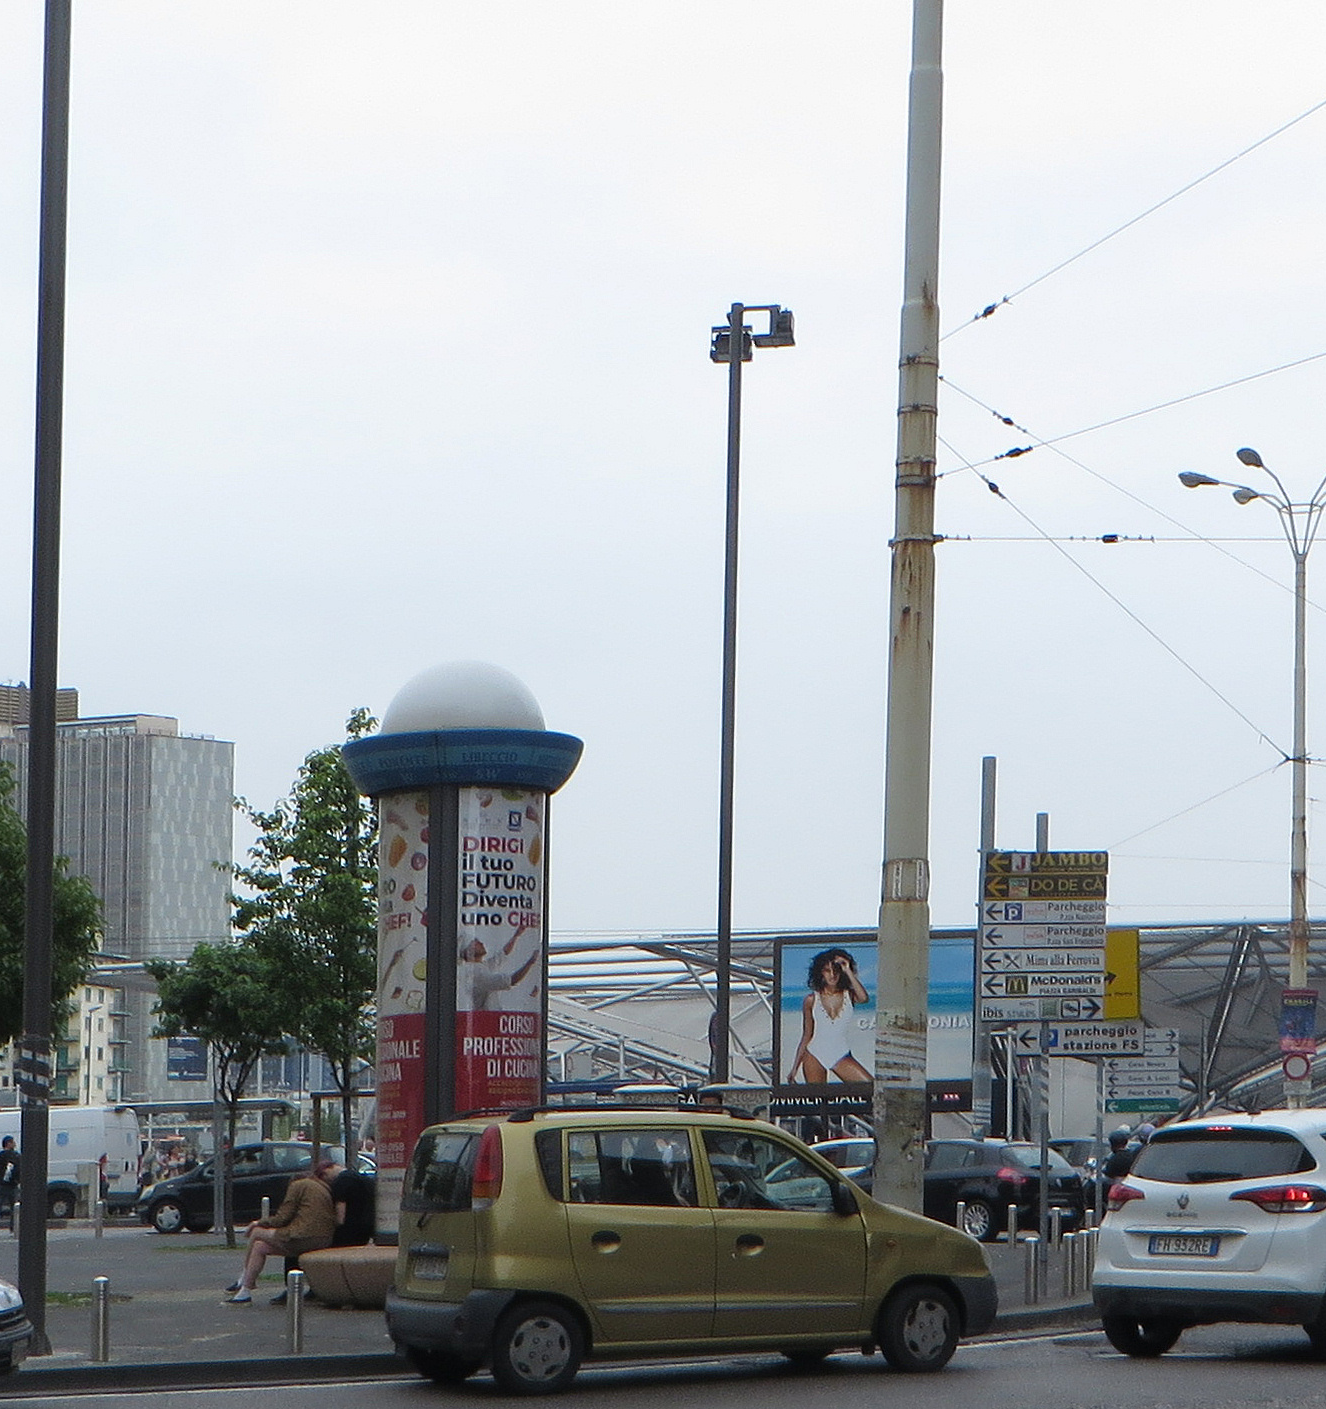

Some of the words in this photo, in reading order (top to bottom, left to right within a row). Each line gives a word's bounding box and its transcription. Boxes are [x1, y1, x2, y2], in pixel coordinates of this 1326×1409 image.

[463, 836, 524, 854] DIRIGI
[462, 852, 474, 870] il
[480, 855, 514, 871] tuo
[1032, 853, 1106, 866] JAMBO
[462, 872, 536, 892] FUTURO
[1030, 880, 1054, 892] DO
[1058, 880, 1078, 891] DE
[462, 890, 533, 909] Diventa
[1048, 902, 1105, 912] Parcheggio
[461, 913, 503, 926] uno
[1047, 925, 1104, 937] Parcheggio
[1030, 974, 1102, 985] McDonald's
[982, 1006, 1004, 1018] ibis
[499, 1015, 534, 1035] CORSO
[1064, 1025, 1138, 1037] parcheggio
[1063, 1040, 1117, 1050] stazione
[1122, 1040, 1139, 1050] FS
[487, 1058, 501, 1078] DI
[1157, 1237, 1170, 1252] FH
